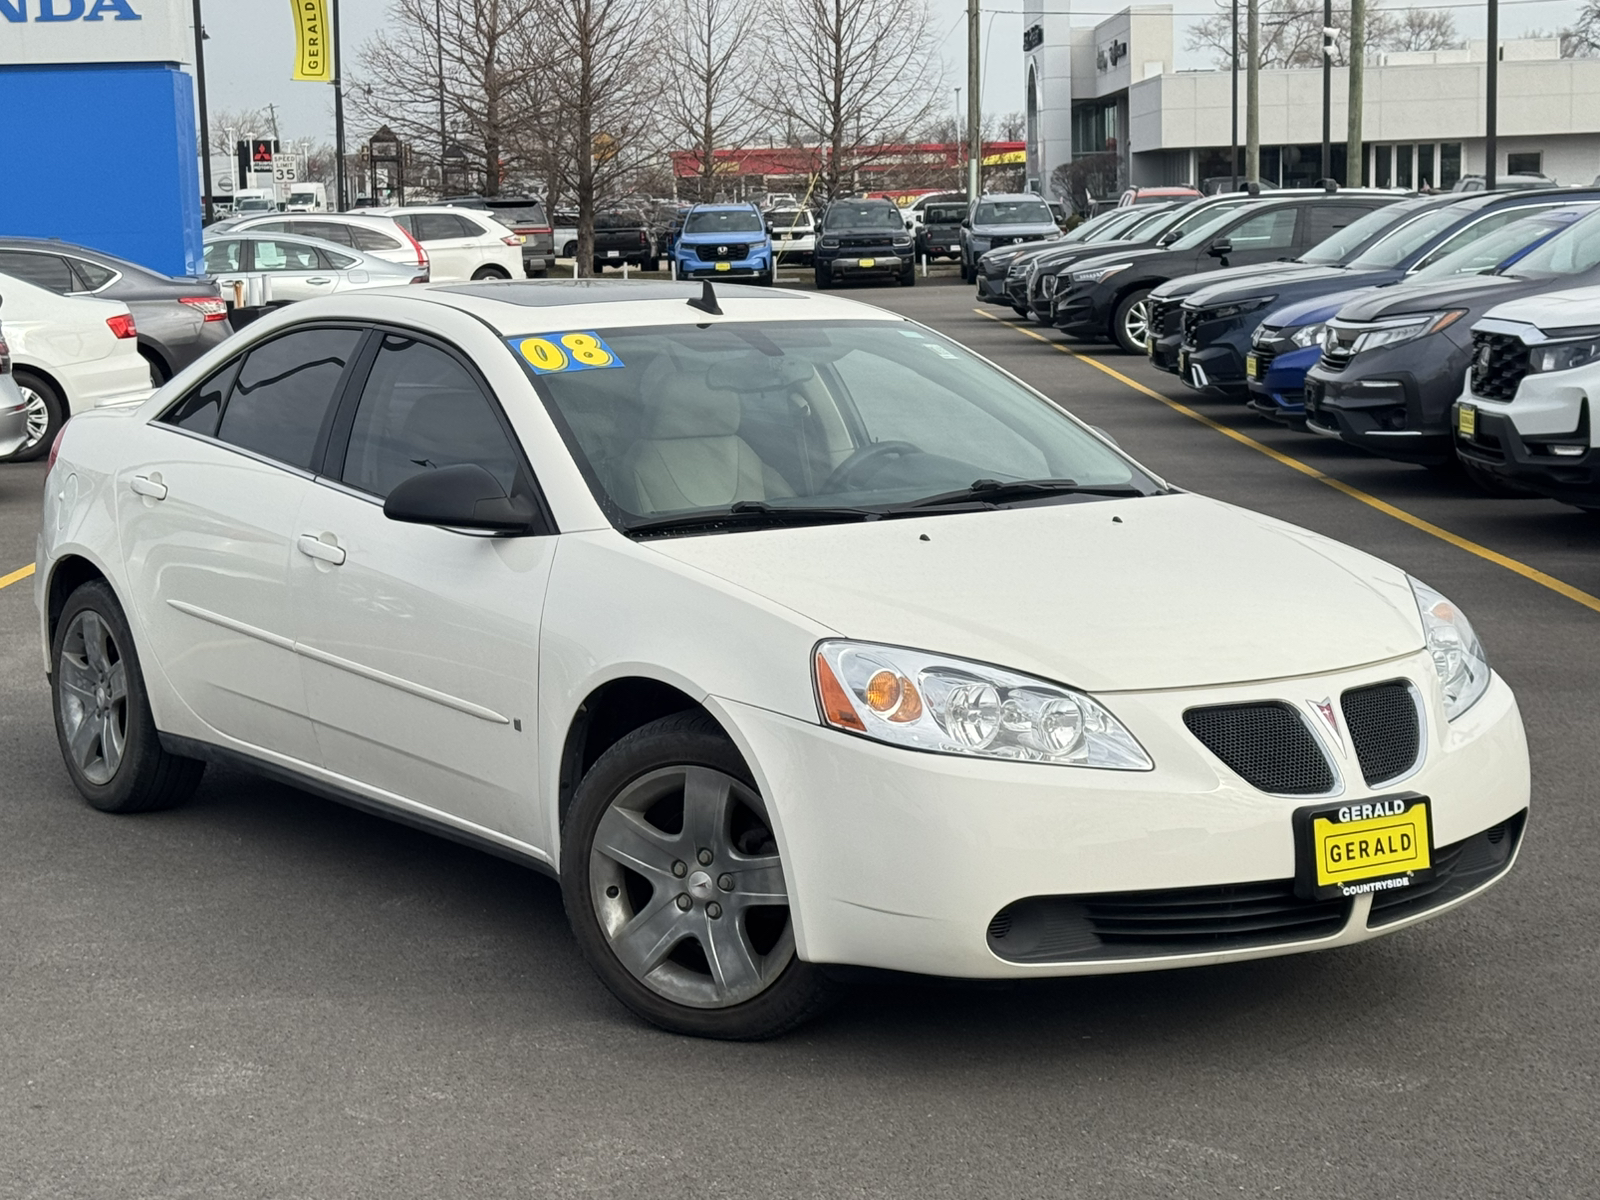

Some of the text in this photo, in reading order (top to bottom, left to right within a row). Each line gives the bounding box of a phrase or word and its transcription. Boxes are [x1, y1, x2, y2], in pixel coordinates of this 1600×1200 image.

[0, 0, 142, 23] DA
[304, 2, 319, 69] GERALD
[276, 169, 296, 180] 35
[520, 333, 614, 372] 08
[1338, 799, 1405, 823] GERALD
[1330, 833, 1412, 863] GERALD
[1343, 877, 1410, 896] COUNTRYSIDE
